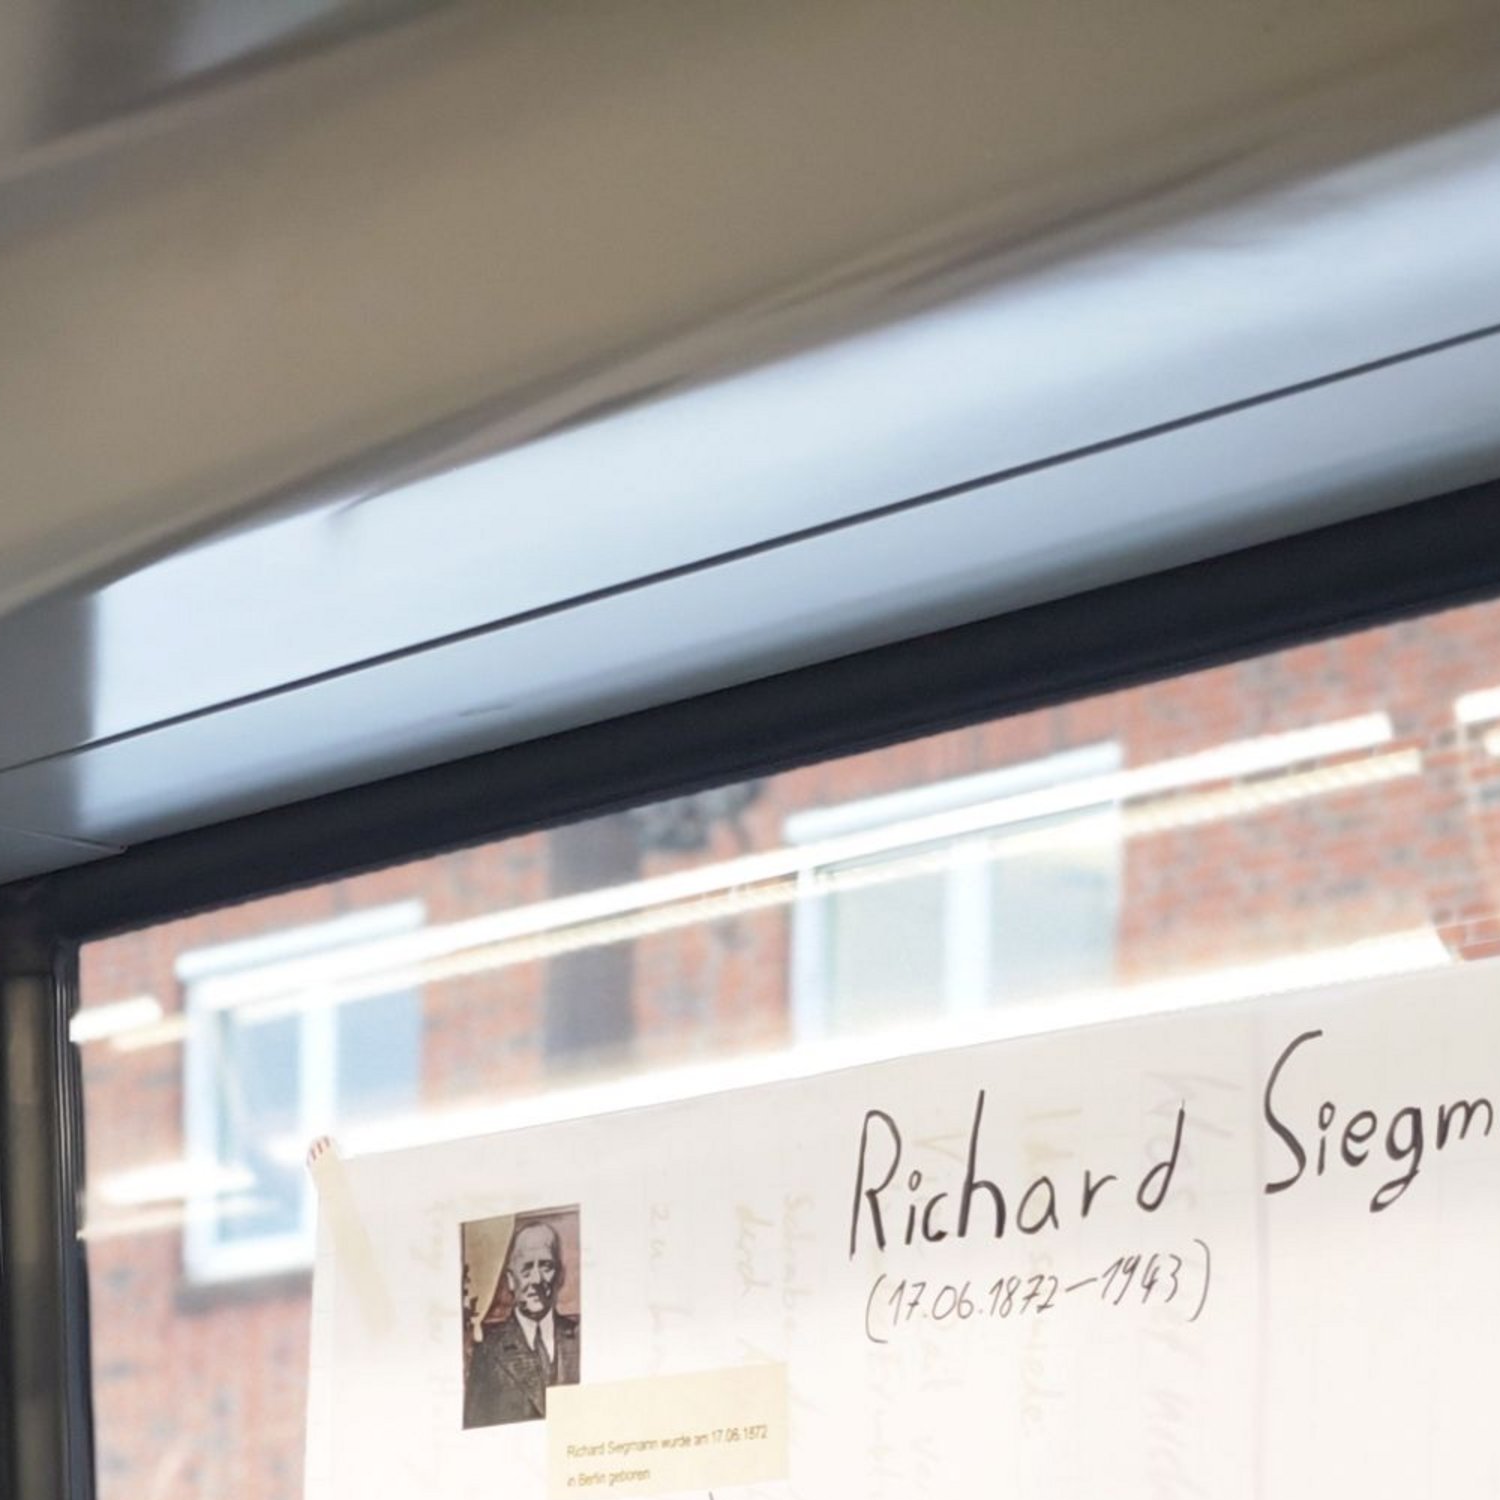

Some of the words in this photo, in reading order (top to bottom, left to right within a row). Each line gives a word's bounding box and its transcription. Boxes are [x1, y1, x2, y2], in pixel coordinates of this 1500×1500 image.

[848, 1088, 1187, 1261] Richard
[567, 1442, 604, 1457] Richard
[661, 1435, 691, 1450] wurde
[579, 1473, 606, 1486] Berlin
